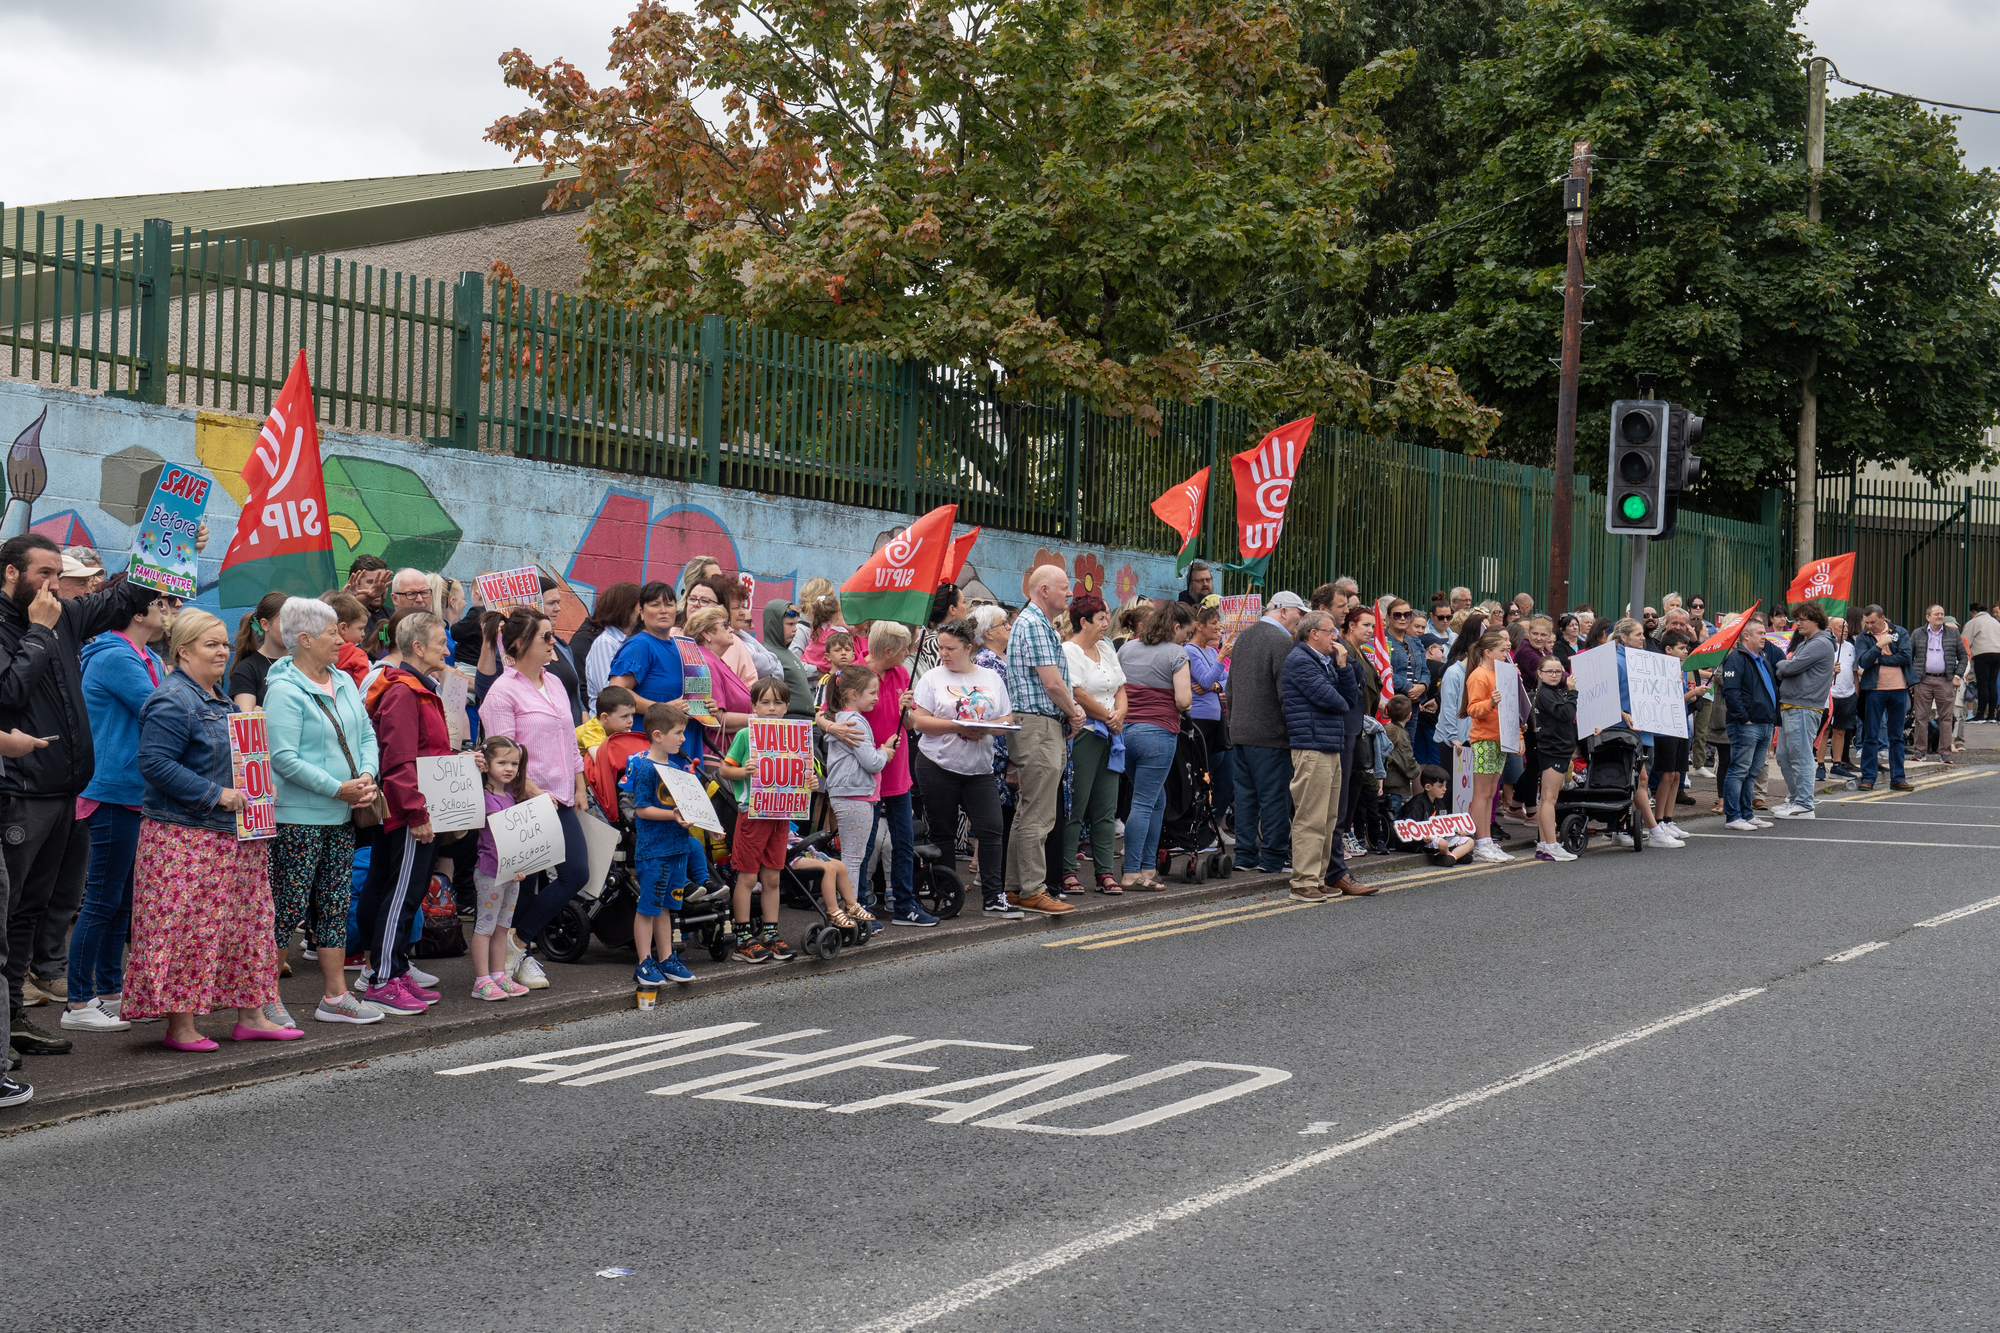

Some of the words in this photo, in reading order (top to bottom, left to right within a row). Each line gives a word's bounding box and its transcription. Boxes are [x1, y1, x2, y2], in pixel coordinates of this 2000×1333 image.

[160, 469, 209, 505] SAVE
[150, 505, 197, 538] Before
[158, 531, 173, 557] 5
[135, 564, 161, 582] FAMILY
[161, 573, 192, 590] CENTRE
[482, 579, 509, 602] WE
[507, 573, 539, 597] NEED
[1804, 584, 1833, 598] SIPTU
[1222, 599, 1236, 610] WE
[1238, 598, 1260, 610] NEED
[676, 640, 706, 666] VALUE
[1578, 654, 1606, 688] GIVE
[1578, 679, 1608, 711] JAXON
[1632, 700, 1683, 729] VOICE
[234, 719, 268, 754] VAL
[753, 723, 809, 752] VALUE
[245, 760, 272, 797] OU
[433, 757, 466, 781] SAVE
[760, 757, 804, 787] OUR
[450, 778, 474, 793] OUR
[439, 797, 475, 812] SCHOOL
[753, 791, 808, 812] CHILDREN
[505, 802, 537, 831] SAVE
[1397, 815, 1474, 839] #OurSIPTU
[520, 823, 542, 843] OUR
[435, 1021, 1293, 1136] AHEAD
